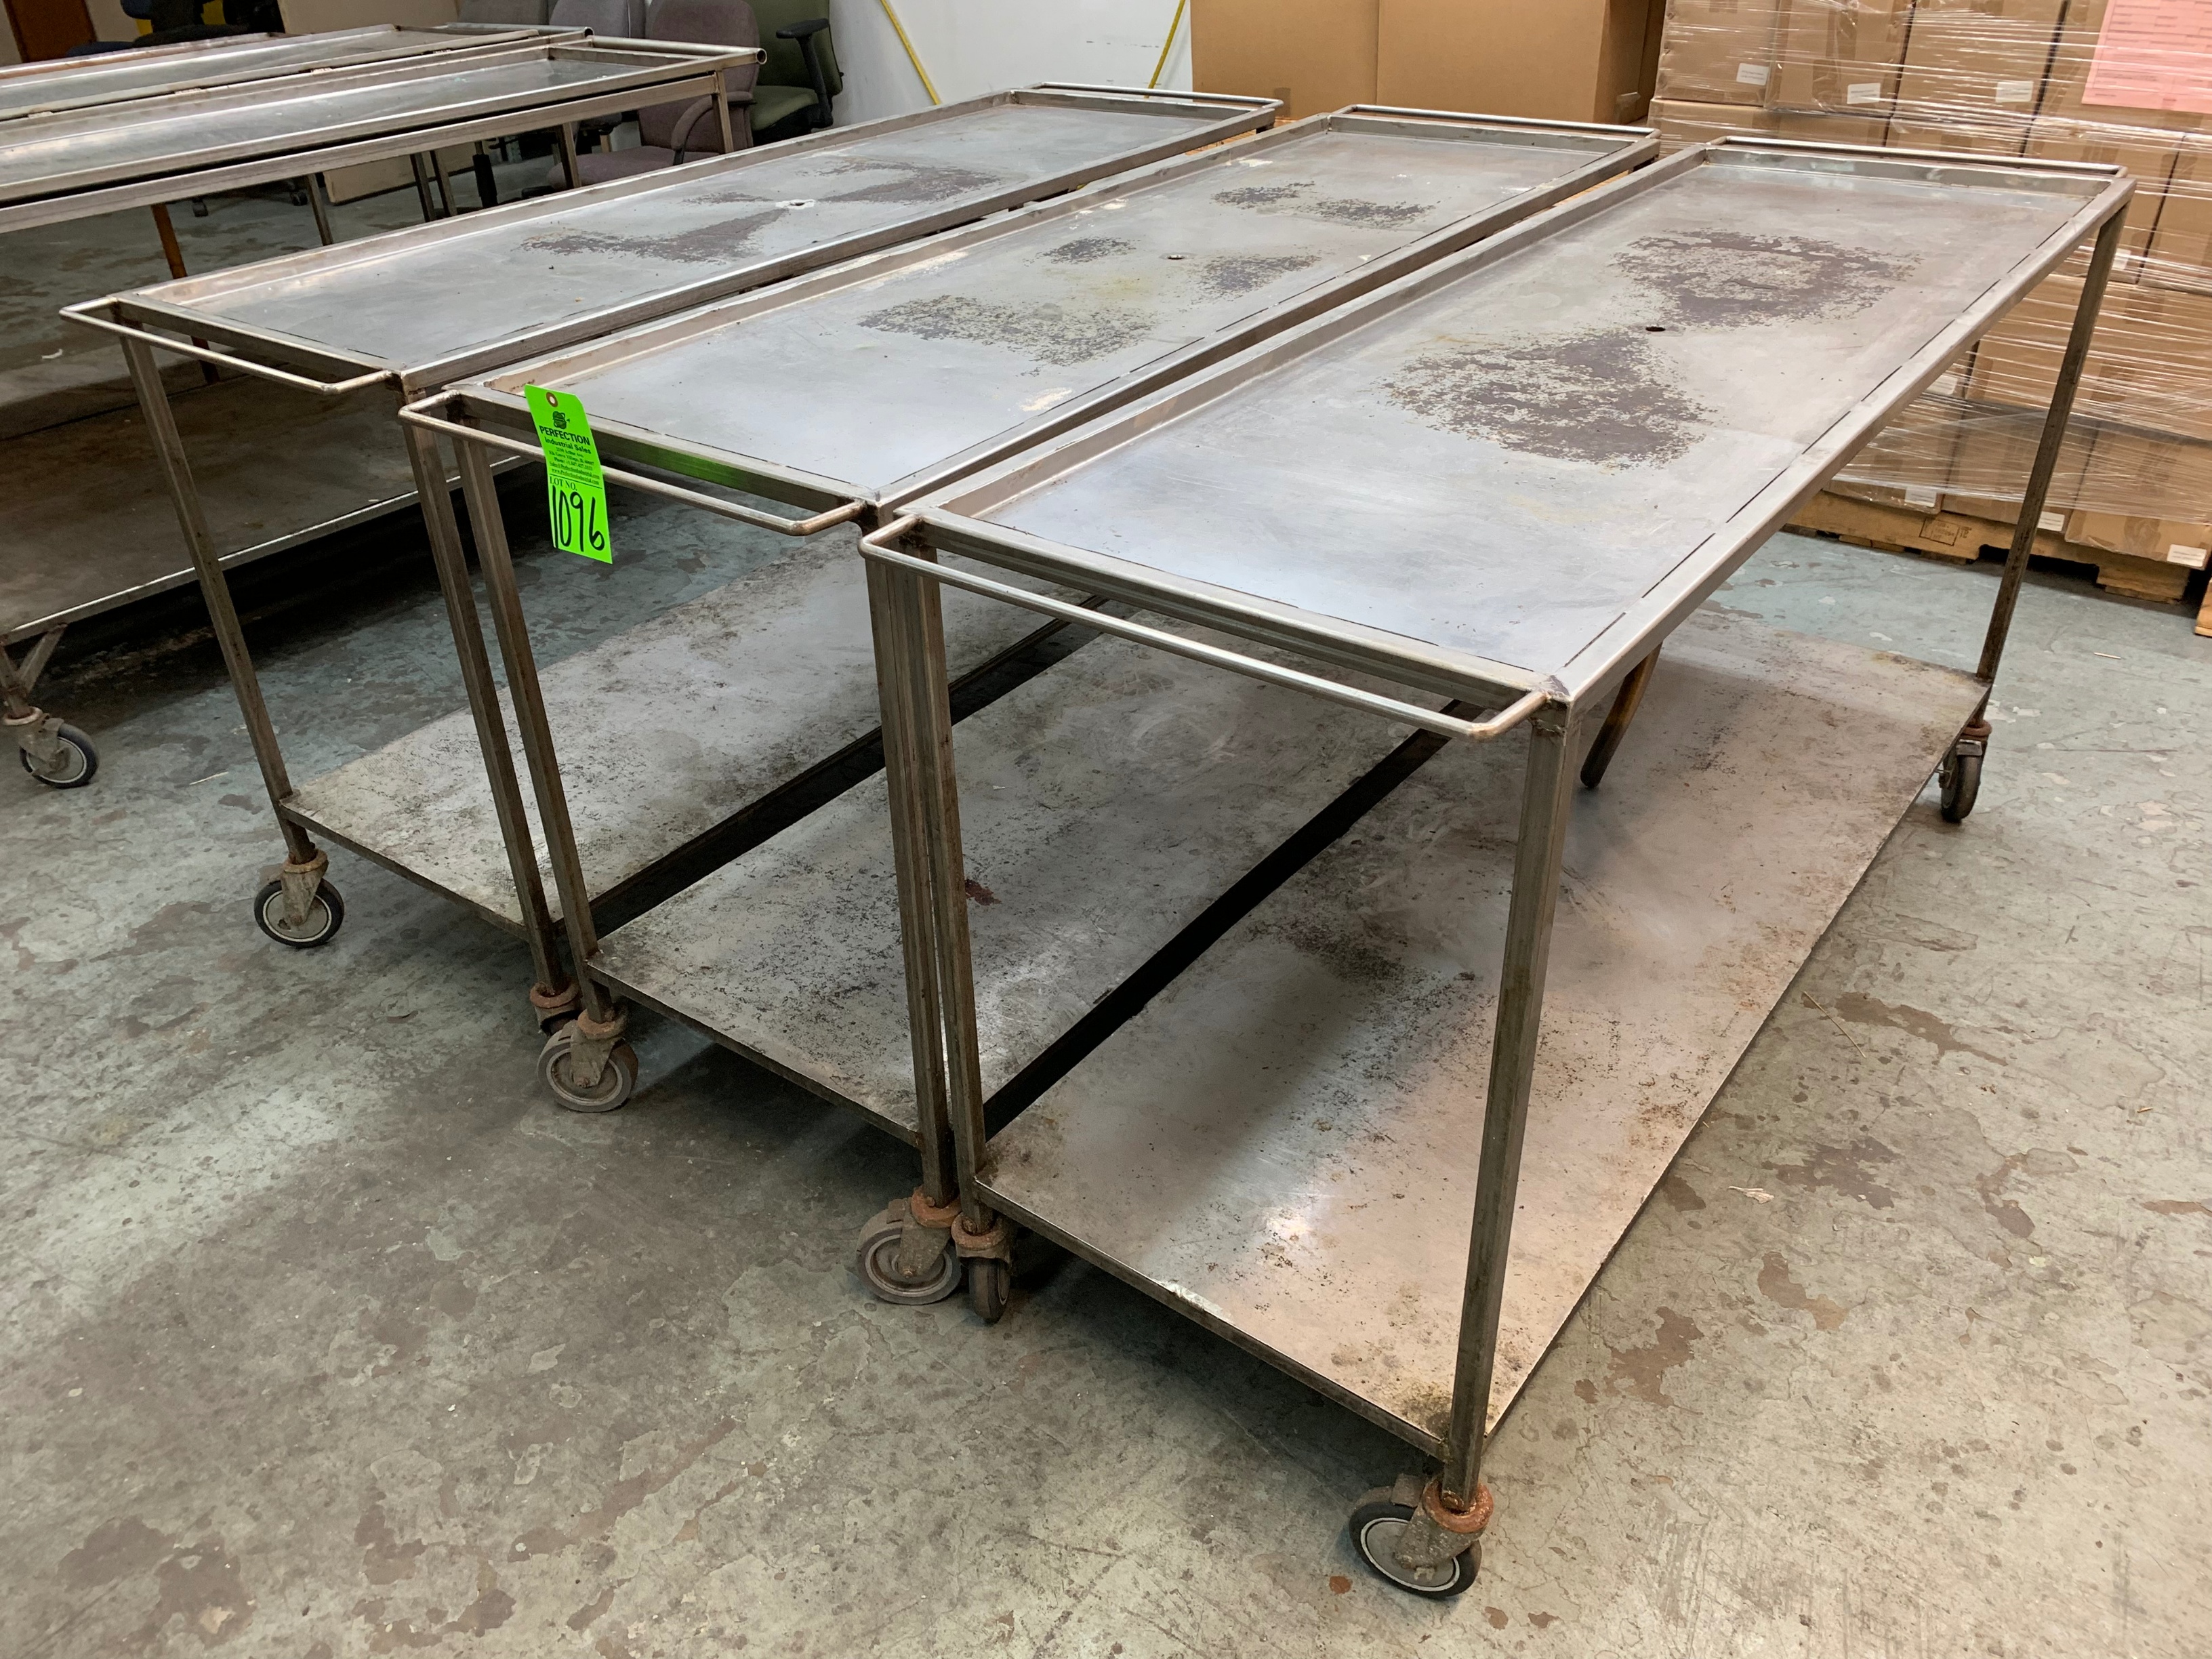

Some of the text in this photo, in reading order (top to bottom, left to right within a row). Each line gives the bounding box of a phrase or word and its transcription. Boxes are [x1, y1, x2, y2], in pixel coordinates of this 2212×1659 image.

[539, 425, 590, 446] PERFECTION
[544, 437, 573, 449] Industrial
[574, 444, 592, 454] Sales
[550, 476, 577, 491] LOT NO.
[552, 485, 605, 552] 1096
